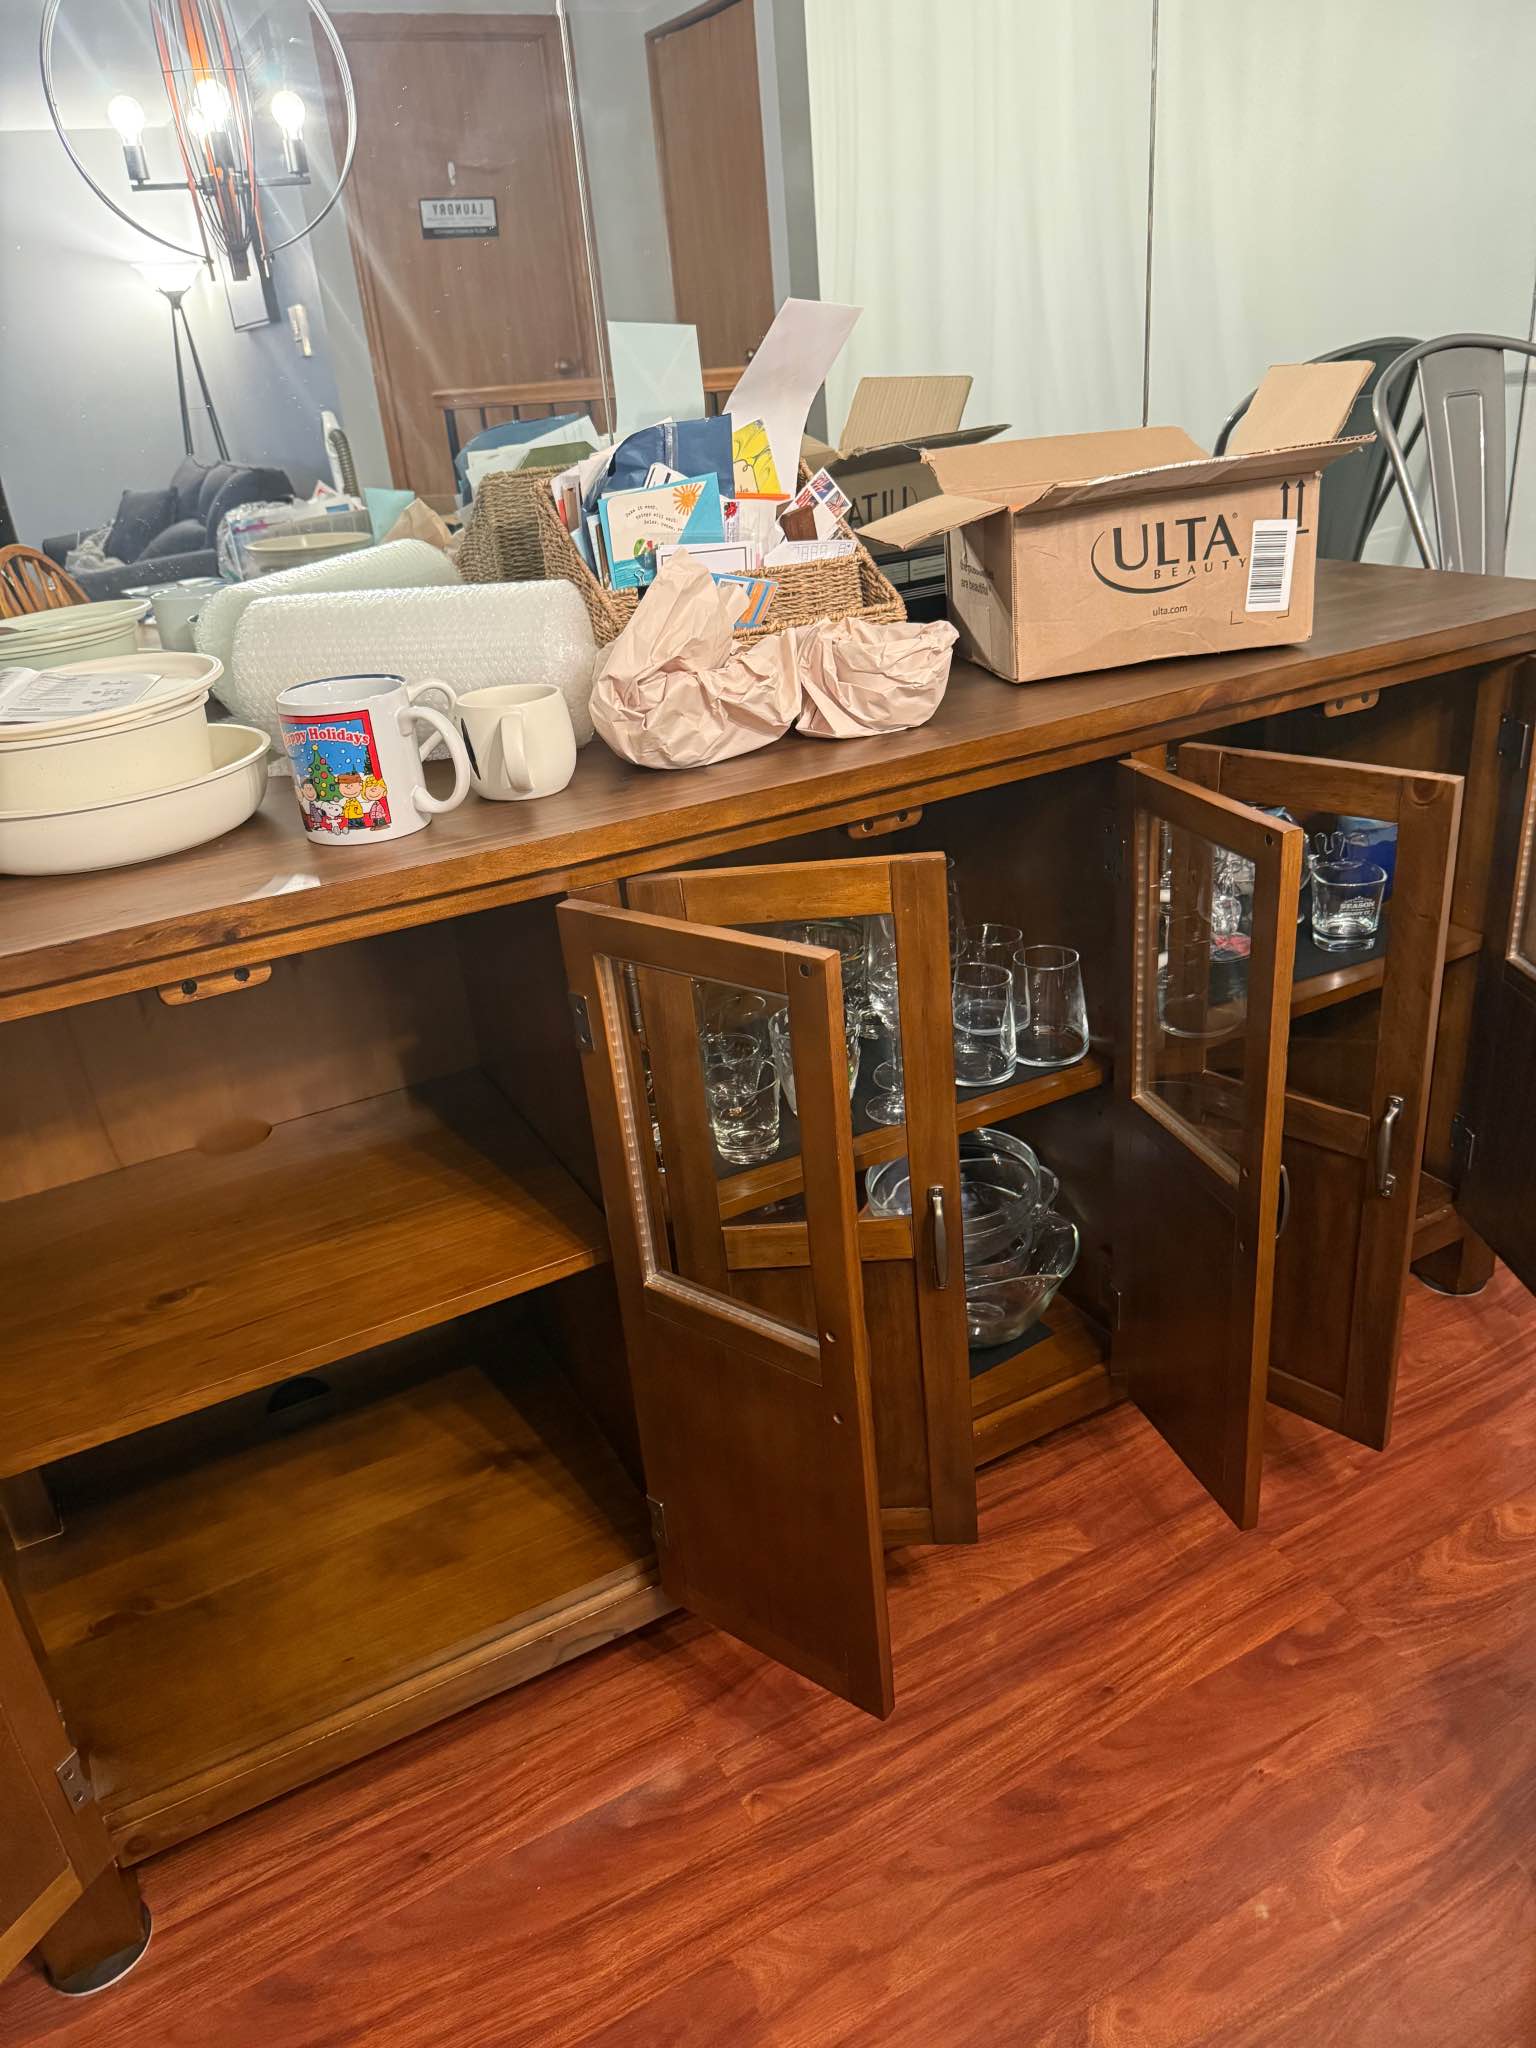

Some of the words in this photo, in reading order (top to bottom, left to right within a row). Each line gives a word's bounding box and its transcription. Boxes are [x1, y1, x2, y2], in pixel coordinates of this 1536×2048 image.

[1113, 514, 1240, 571] ULTA
[1154, 557, 1248, 579] BEAUTY
[1152, 604, 1188, 616] ulta.com
[308, 727, 369, 745] Holidays
